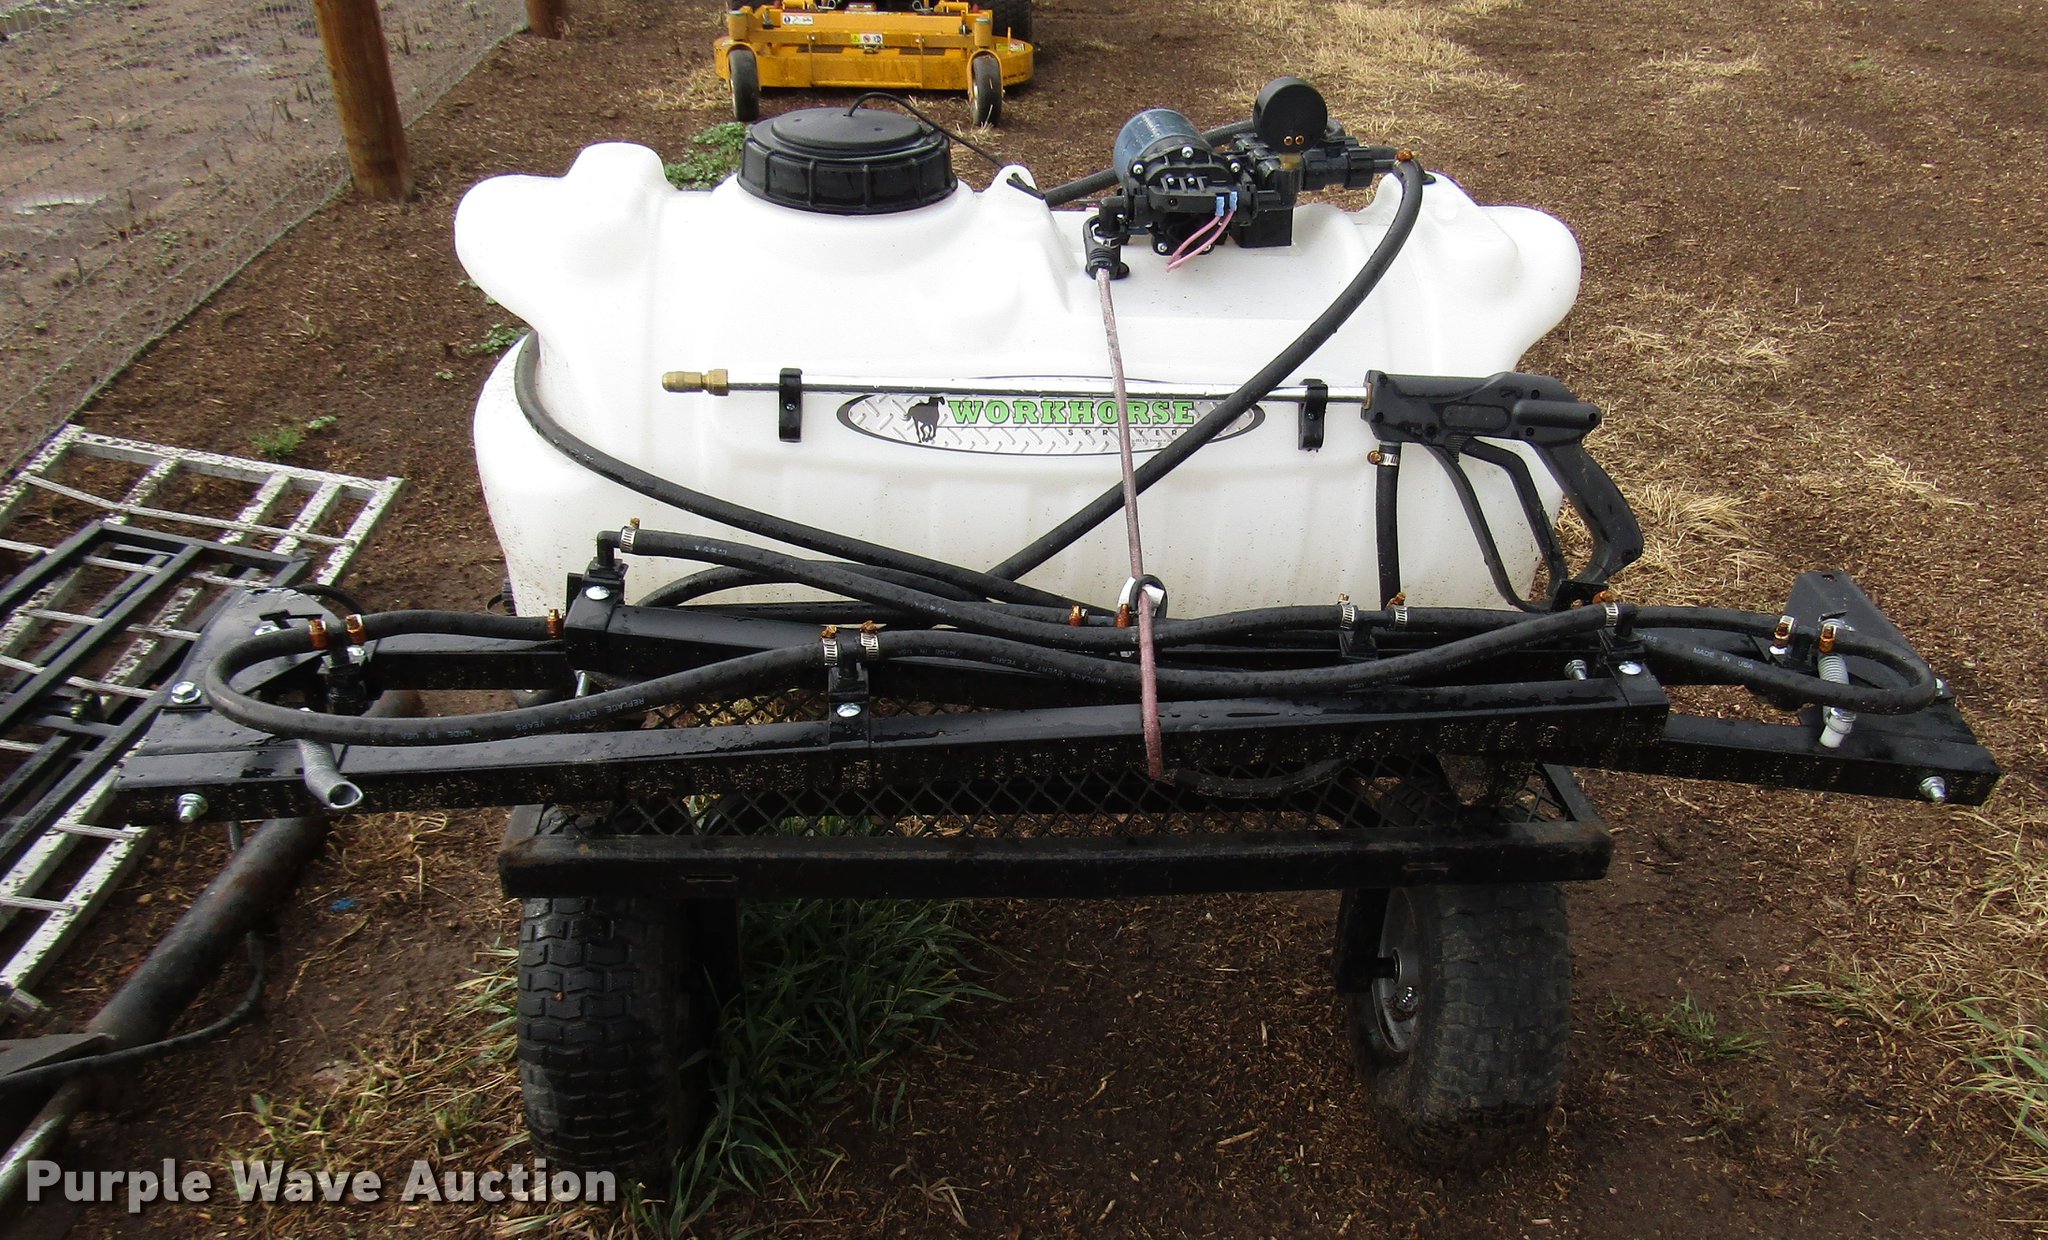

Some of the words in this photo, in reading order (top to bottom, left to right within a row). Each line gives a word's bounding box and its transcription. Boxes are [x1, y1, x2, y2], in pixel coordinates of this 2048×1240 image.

[949, 400, 1195, 425] WORKHORSE
[1692, 646, 1715, 658] MADE
[1721, 655, 1730, 663] IN
[603, 697, 645, 713] REPLACE
[568, 708, 598, 721] EVERY
[514, 719, 546, 731] YEARS
